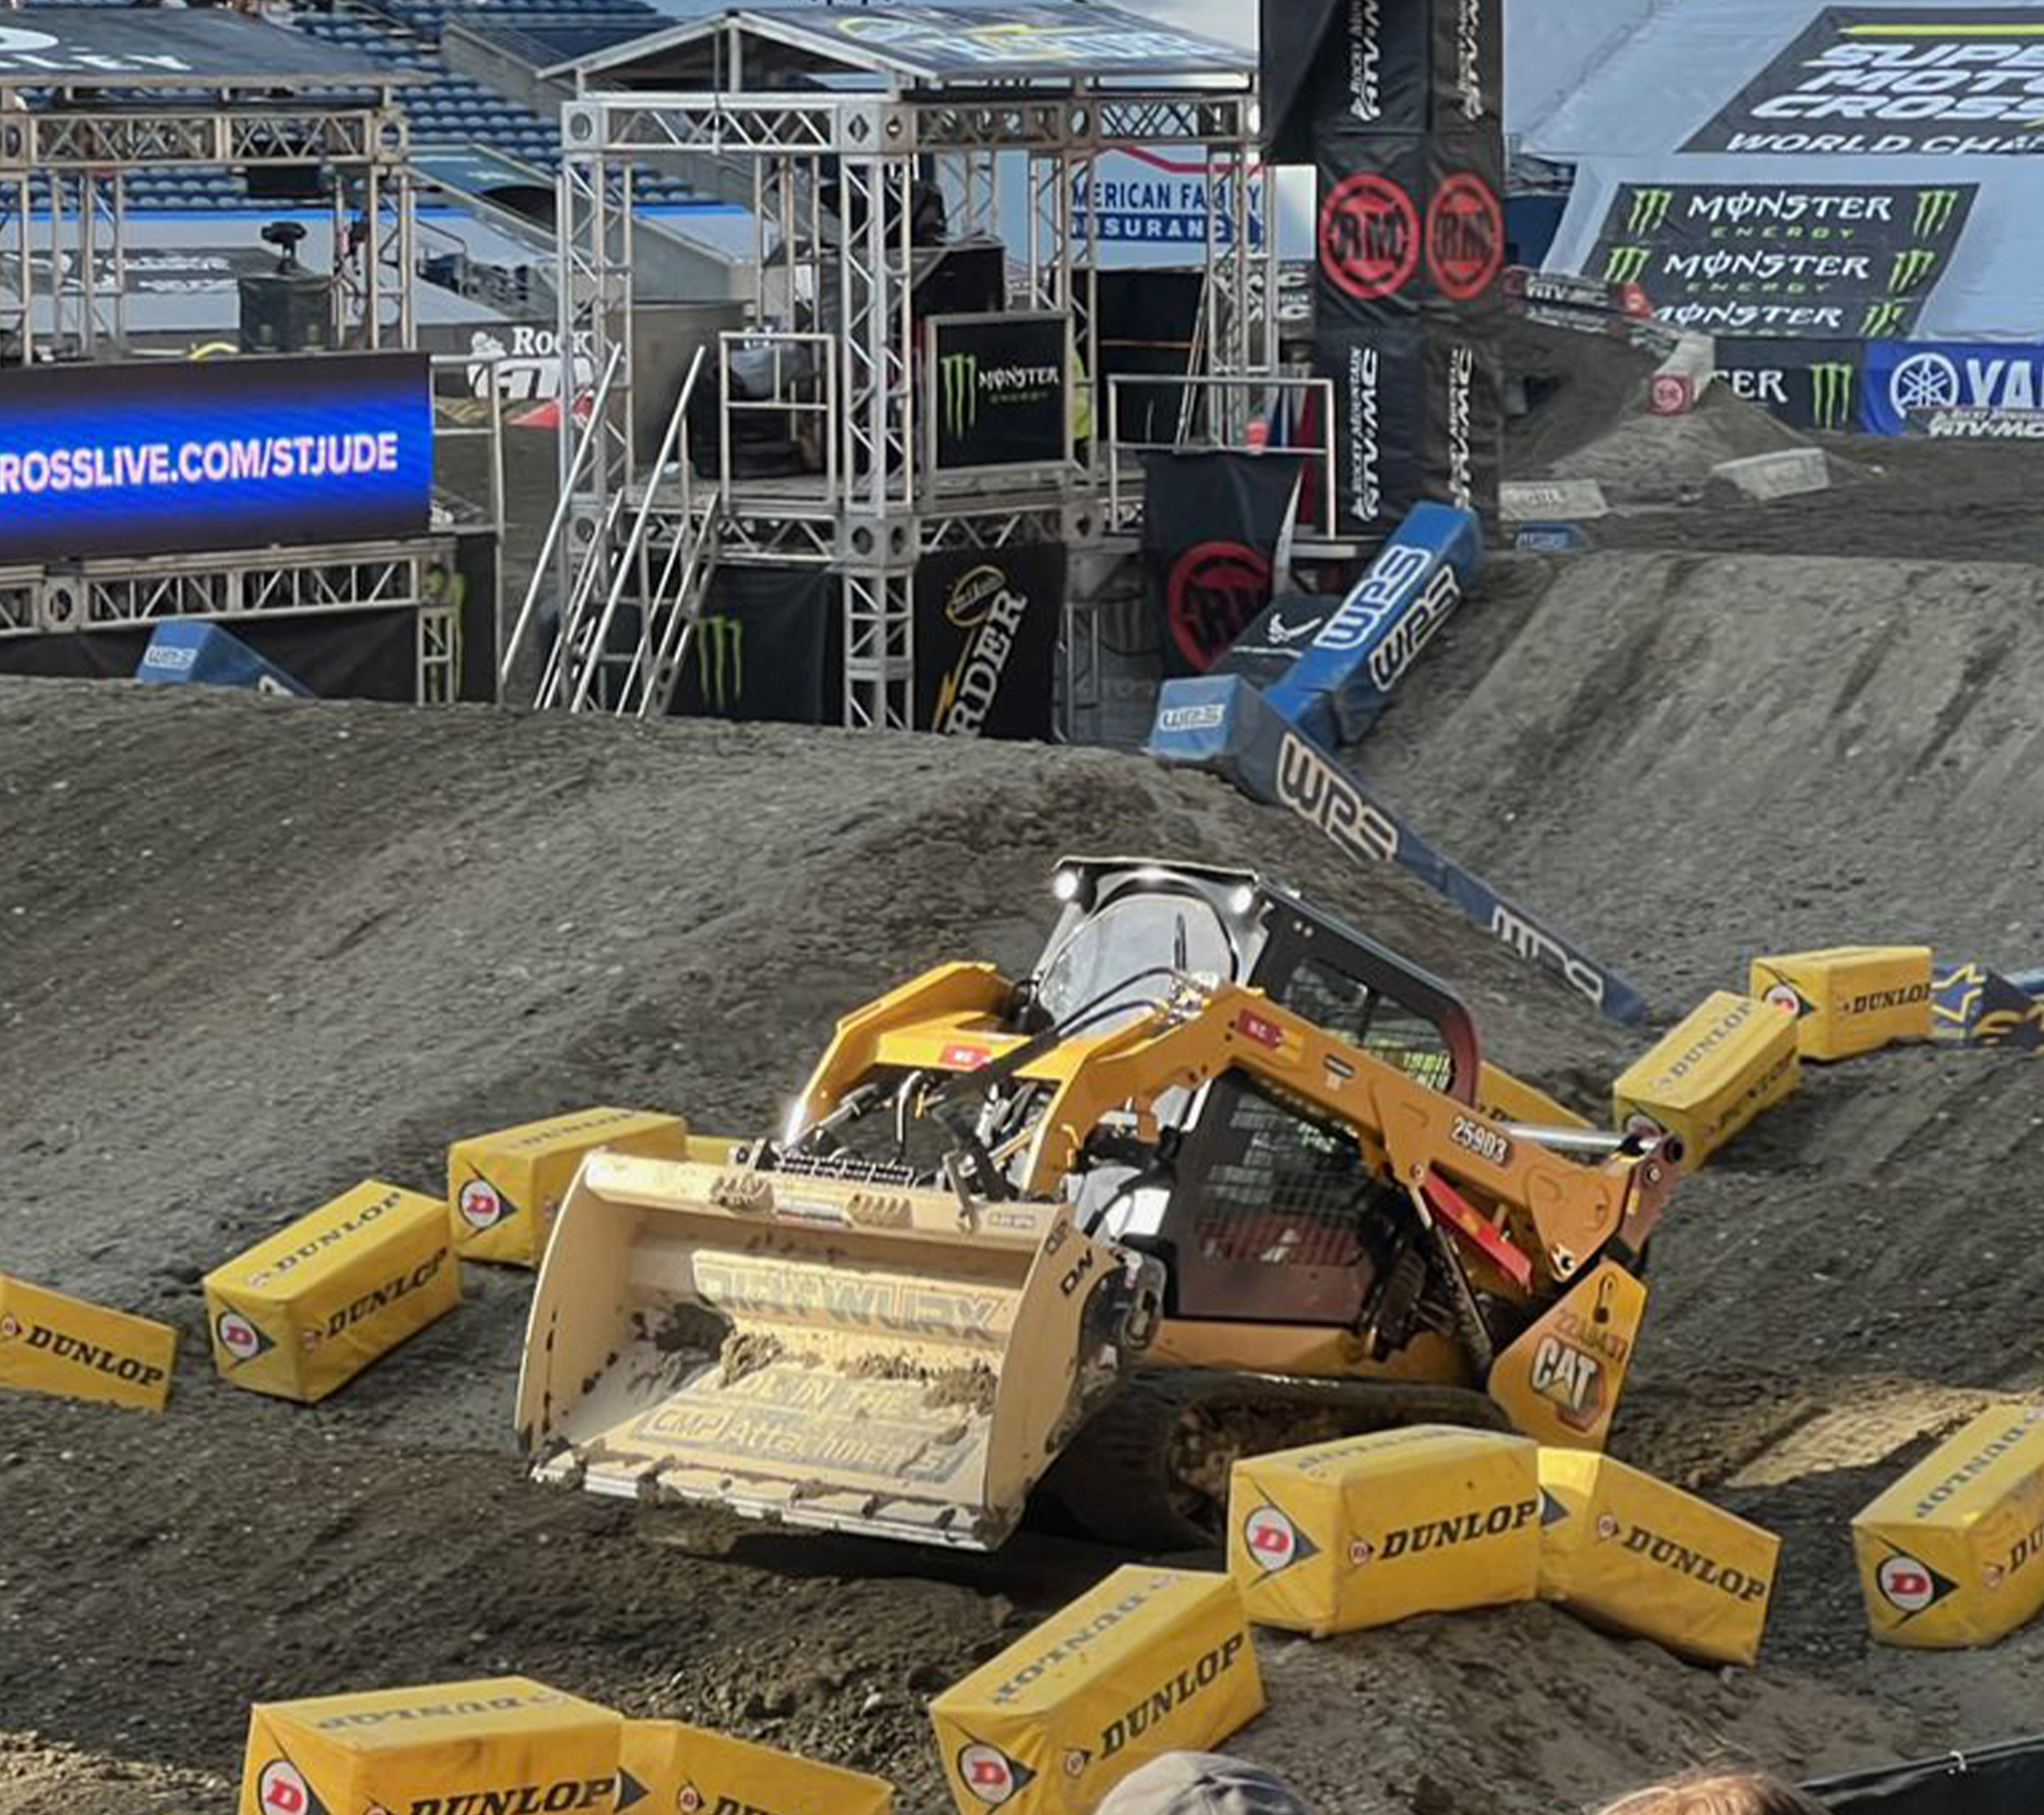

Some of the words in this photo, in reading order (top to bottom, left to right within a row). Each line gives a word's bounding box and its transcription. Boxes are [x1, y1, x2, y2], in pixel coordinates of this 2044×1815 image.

[1726, 132, 1913, 153] WORLD
[1711, 226, 1854, 239] ENERGY
[0, 432, 398, 494] ROSSLIVE.COM/STJUDE
[1312, 545, 1431, 650] WPS
[1369, 564, 1461, 692] WPS
[274, 1190, 402, 1270] DUNLOP
[27, 1324, 164, 1387] DUNLOP
[1531, 1335, 1598, 1413] CAT
[1253, 1524, 1289, 1553] D
[1380, 1499, 1539, 1560] DUNLOP
[1622, 1525, 1764, 1603] DUNLOP
[1100, 1632, 1243, 1760] DUNLOP
[267, 1779, 303, 1813] D
[409, 1777, 617, 1815] DUNLOP
[971, 1760, 1006, 1785] D
